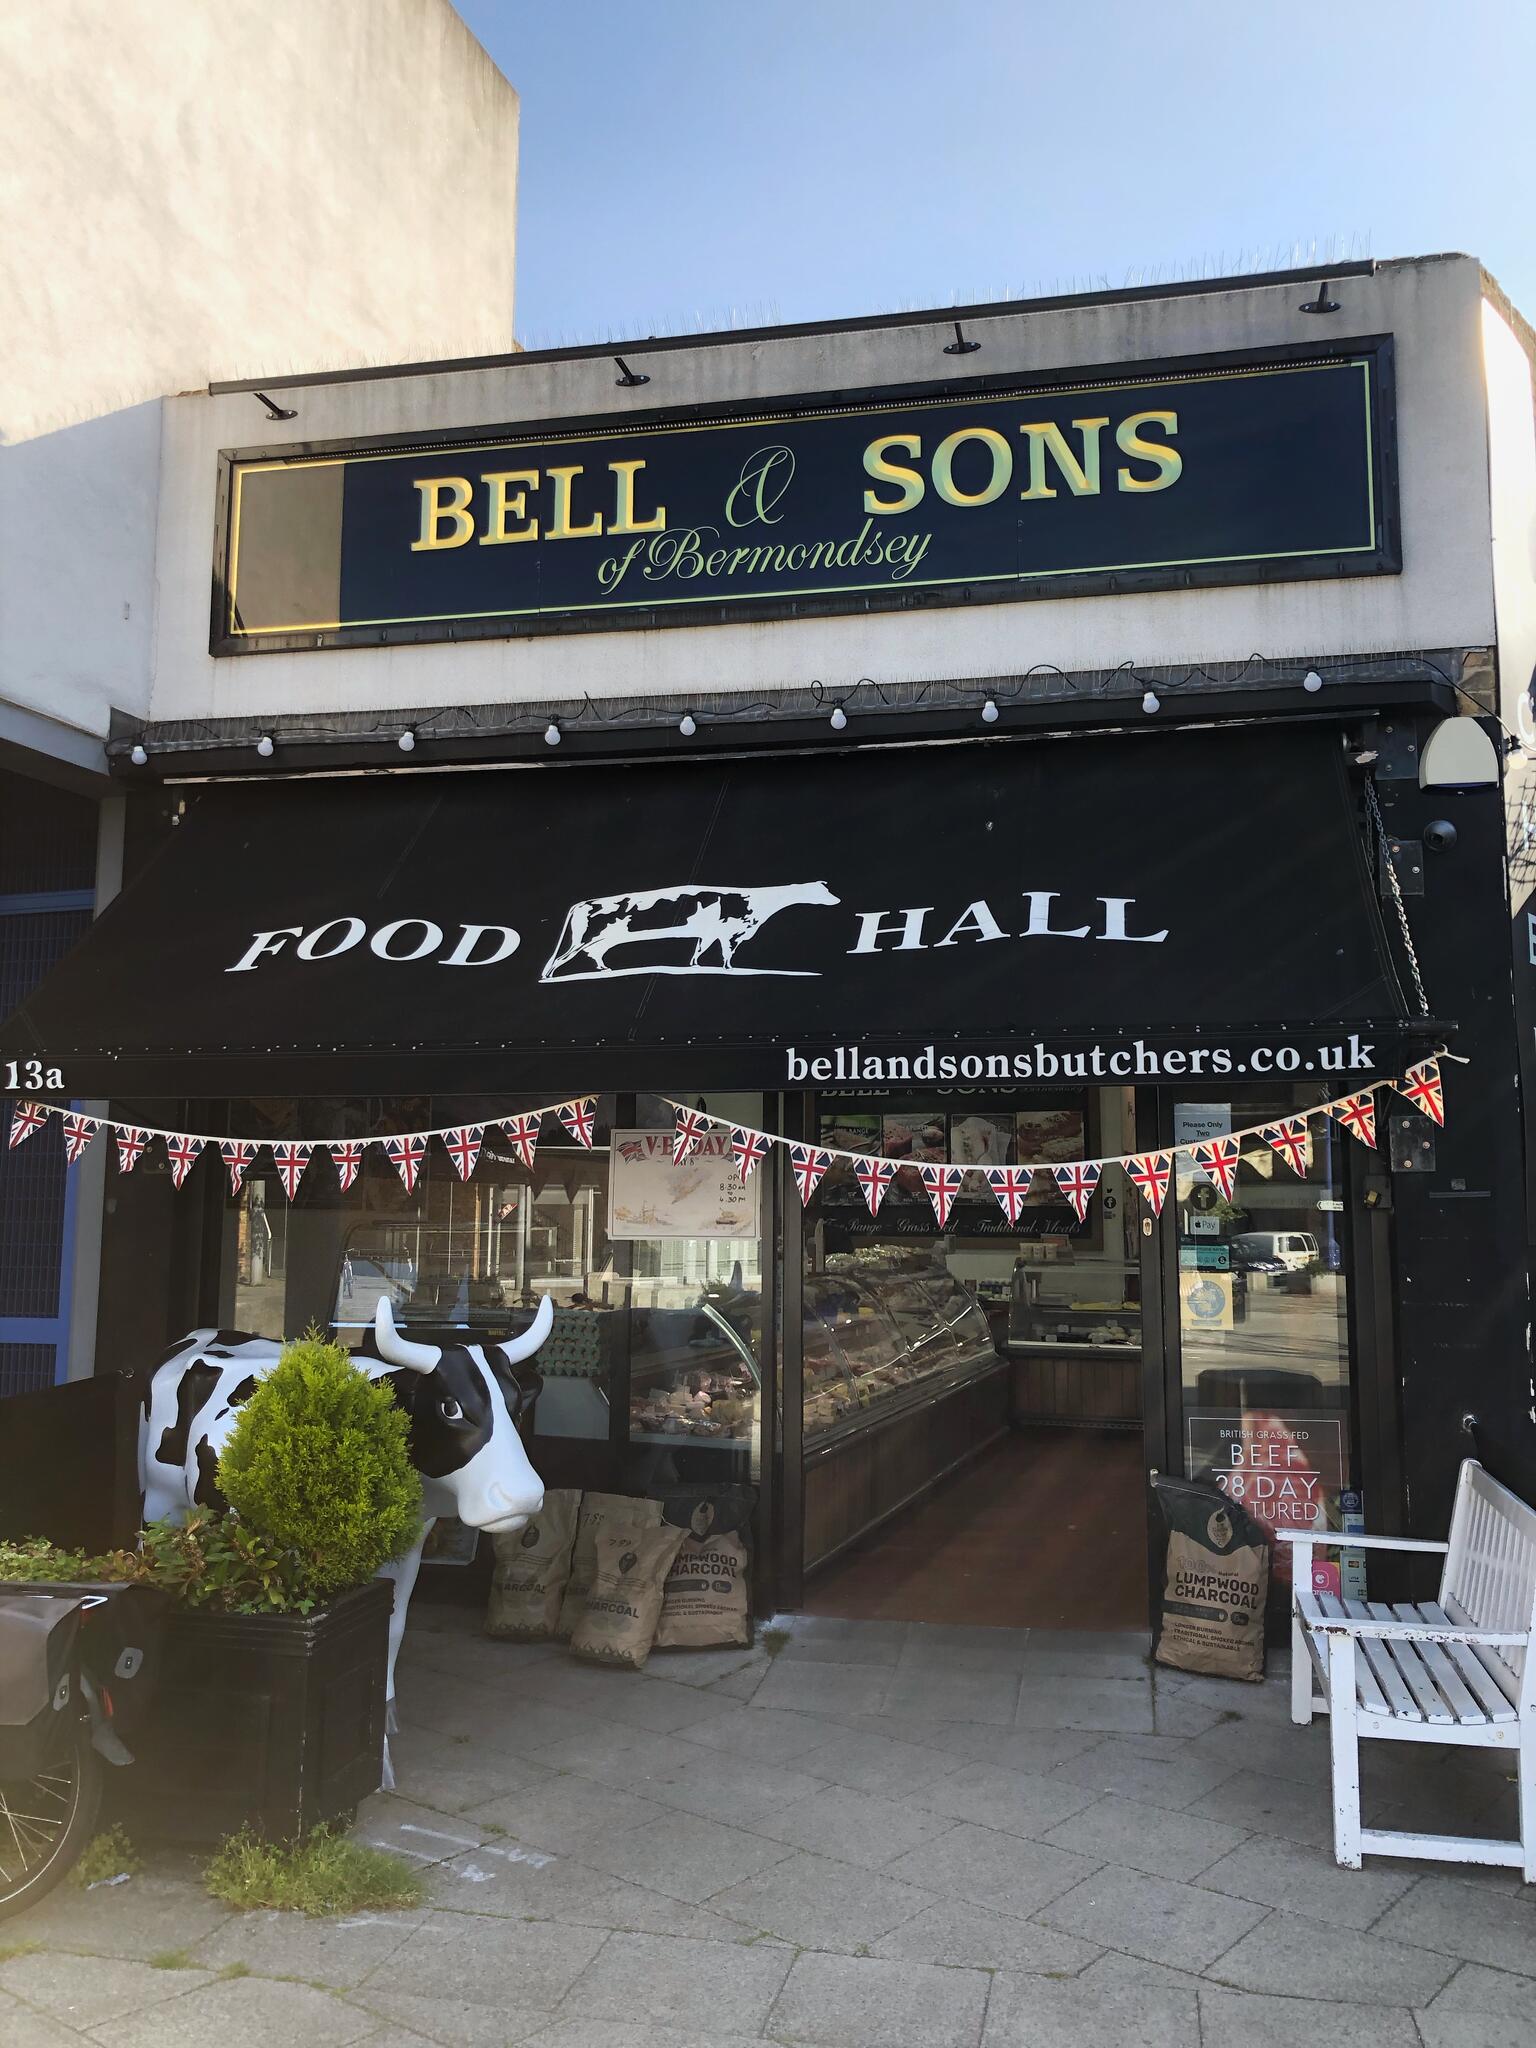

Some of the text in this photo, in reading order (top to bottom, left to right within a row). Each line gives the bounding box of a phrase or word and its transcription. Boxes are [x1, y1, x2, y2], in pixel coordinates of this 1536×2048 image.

[411, 410, 1184, 551] BELL & SONS
[598, 517, 933, 595] of Bermondsey
[224, 891, 1170, 974] FOOD HALL
[786, 1034, 1376, 1081] bellandsonsbutchers.co.uk
[4, 1058, 65, 1091] 13a
[1207, 1121, 1223, 1129] Only
[1202, 1220, 1216, 1229] Pay
[1220, 1429, 1254, 1438] BRITISH
[1291, 1431, 1310, 1440] FED
[1231, 1443, 1299, 1467] BEEF
[1215, 1474, 1318, 1499] 28 DAY
[1249, 1500, 1320, 1521] TURED
[1175, 1571, 1260, 1596] LUMPWOOD
[1174, 1584, 1258, 1610] CHARCOAL
